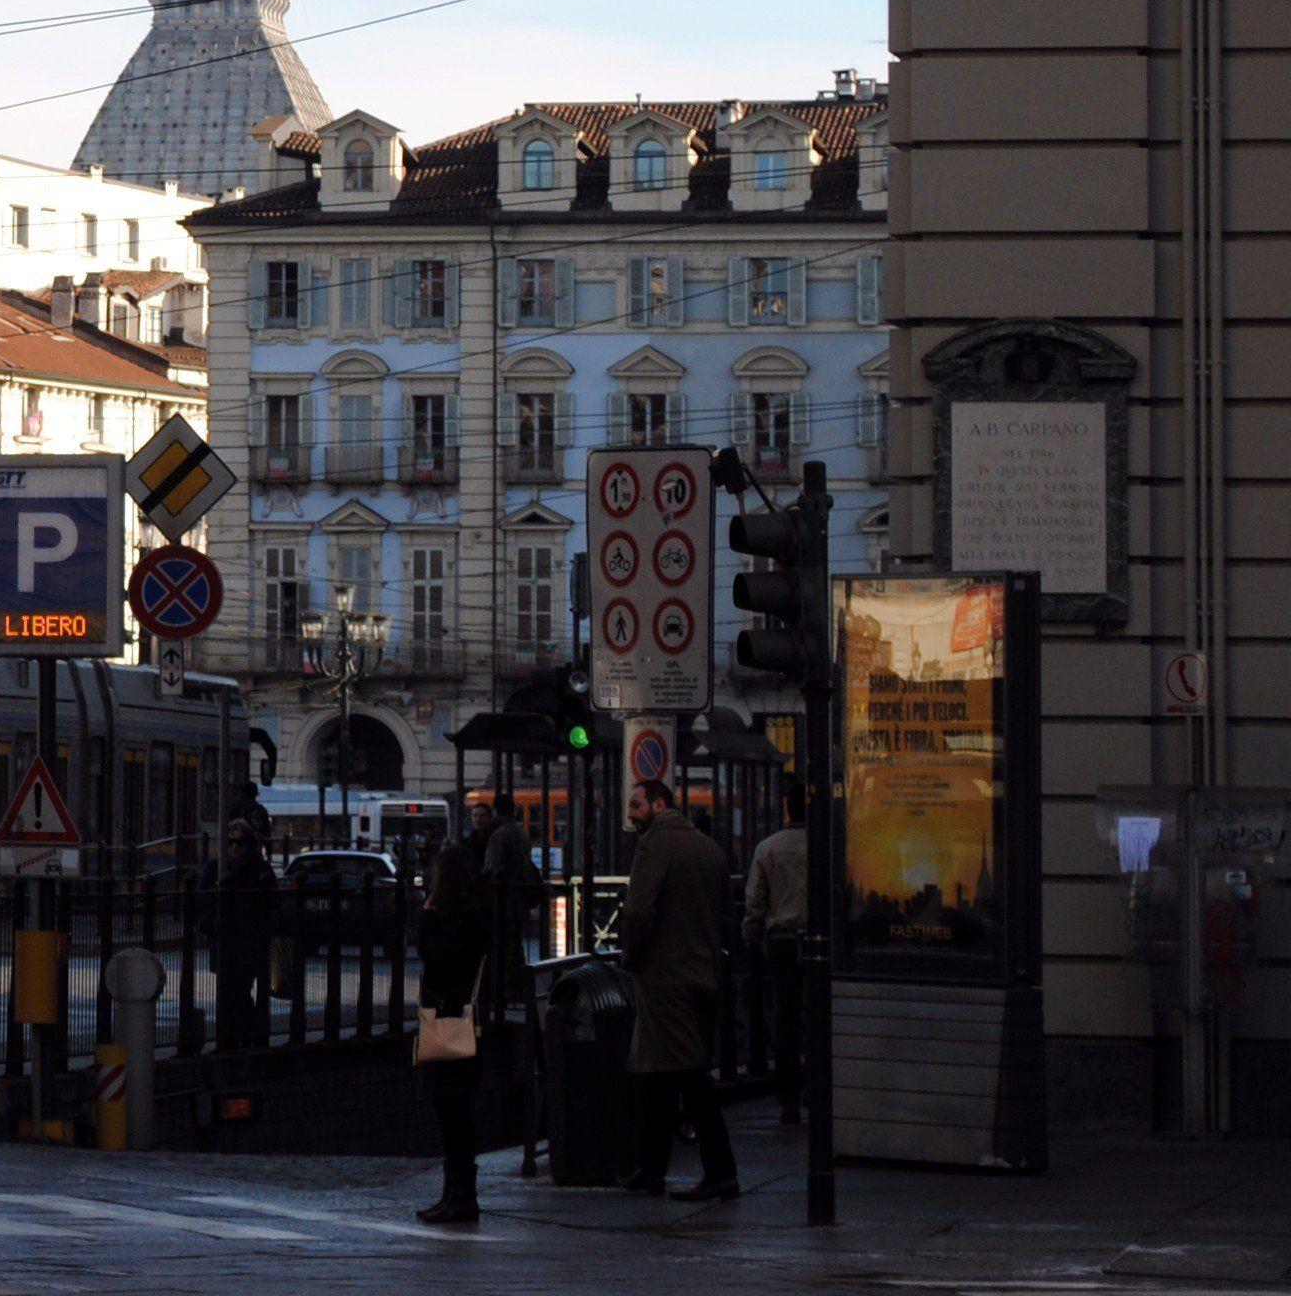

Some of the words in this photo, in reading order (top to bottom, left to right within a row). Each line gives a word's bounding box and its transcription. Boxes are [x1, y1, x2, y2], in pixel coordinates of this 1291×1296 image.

[1006, 421, 1089, 437] CARPANO
[17, 512, 79, 592] P
[4, 614, 87, 637] LIBERO
[869, 674, 899, 694] SIAMO
[890, 924, 953, 941] FASTWEB
